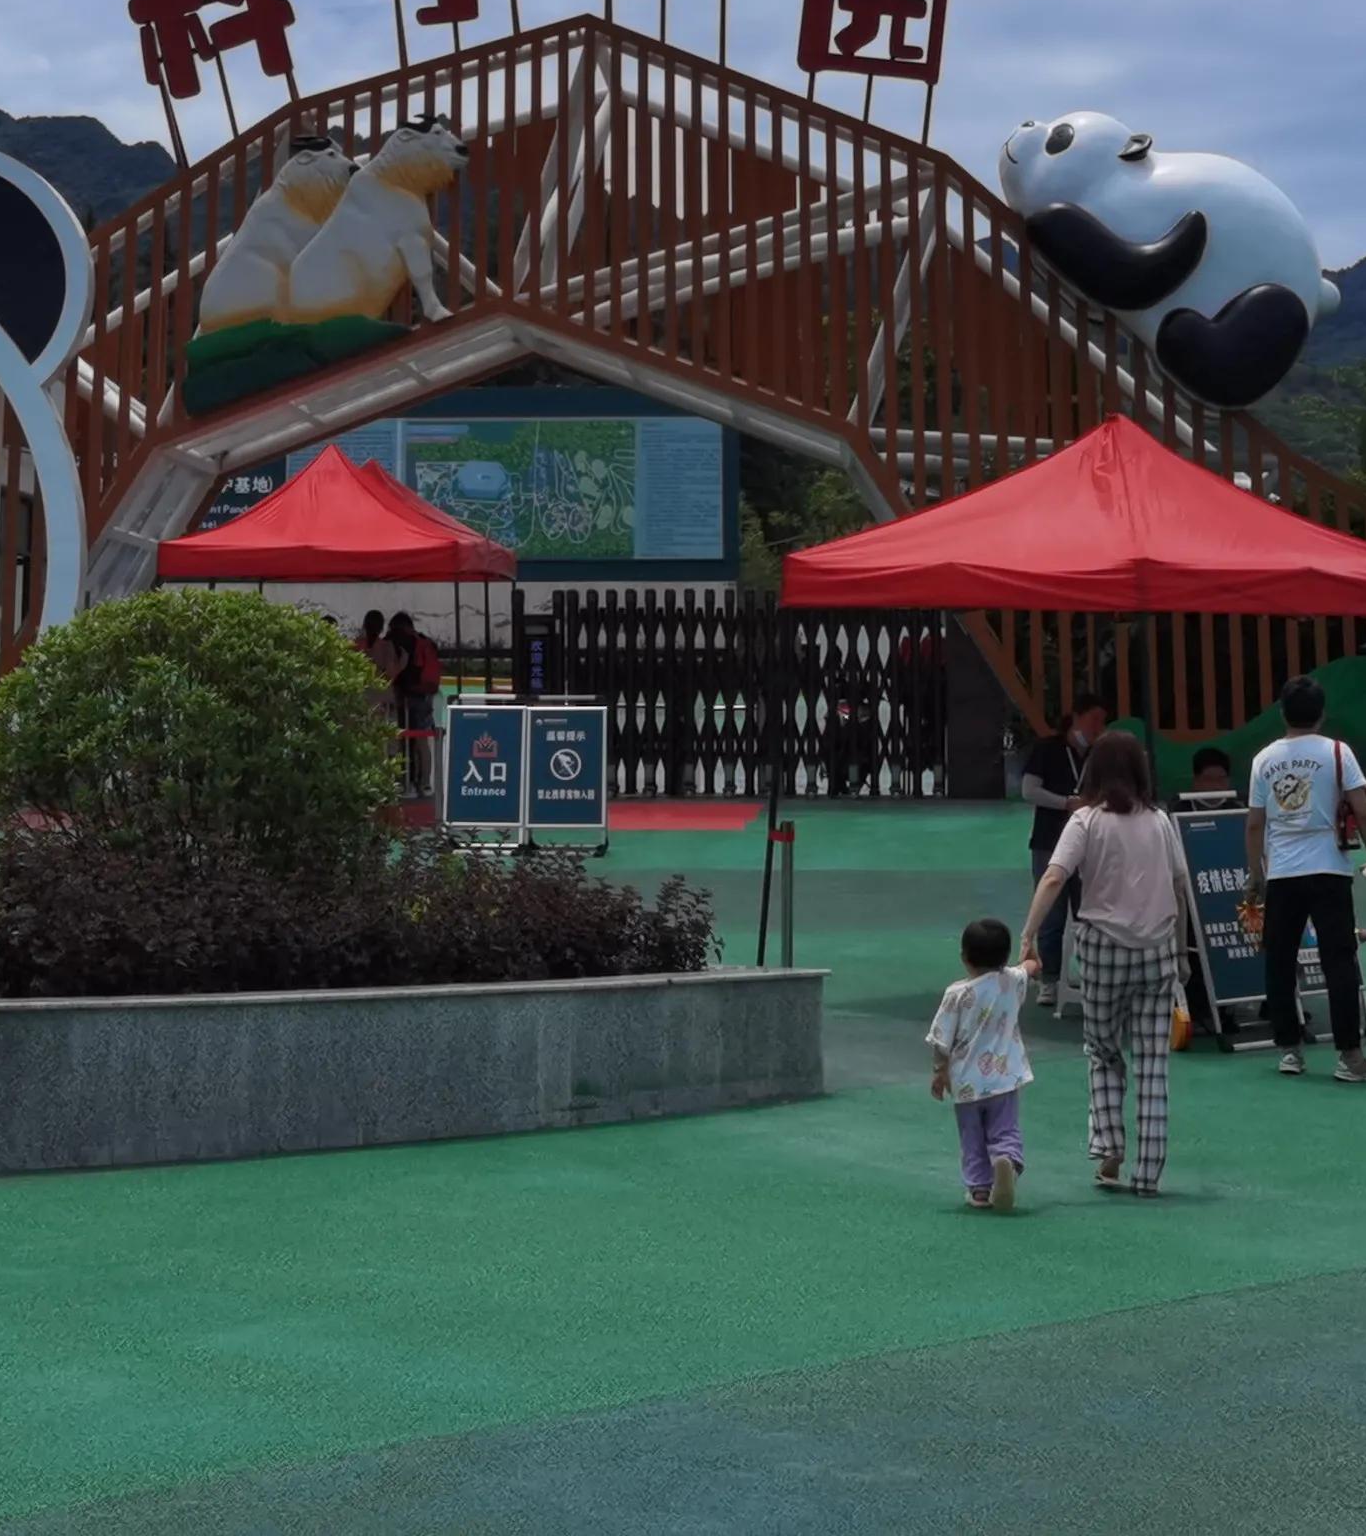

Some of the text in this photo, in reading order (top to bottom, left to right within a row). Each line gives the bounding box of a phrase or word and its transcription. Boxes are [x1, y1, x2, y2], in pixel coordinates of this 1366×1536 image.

[463, 760, 507, 783] 入口
[1291, 759, 1323, 772] PARTY
[461, 785, 507, 797] Entrance
[1197, 866, 1250, 895] 疫情检测
